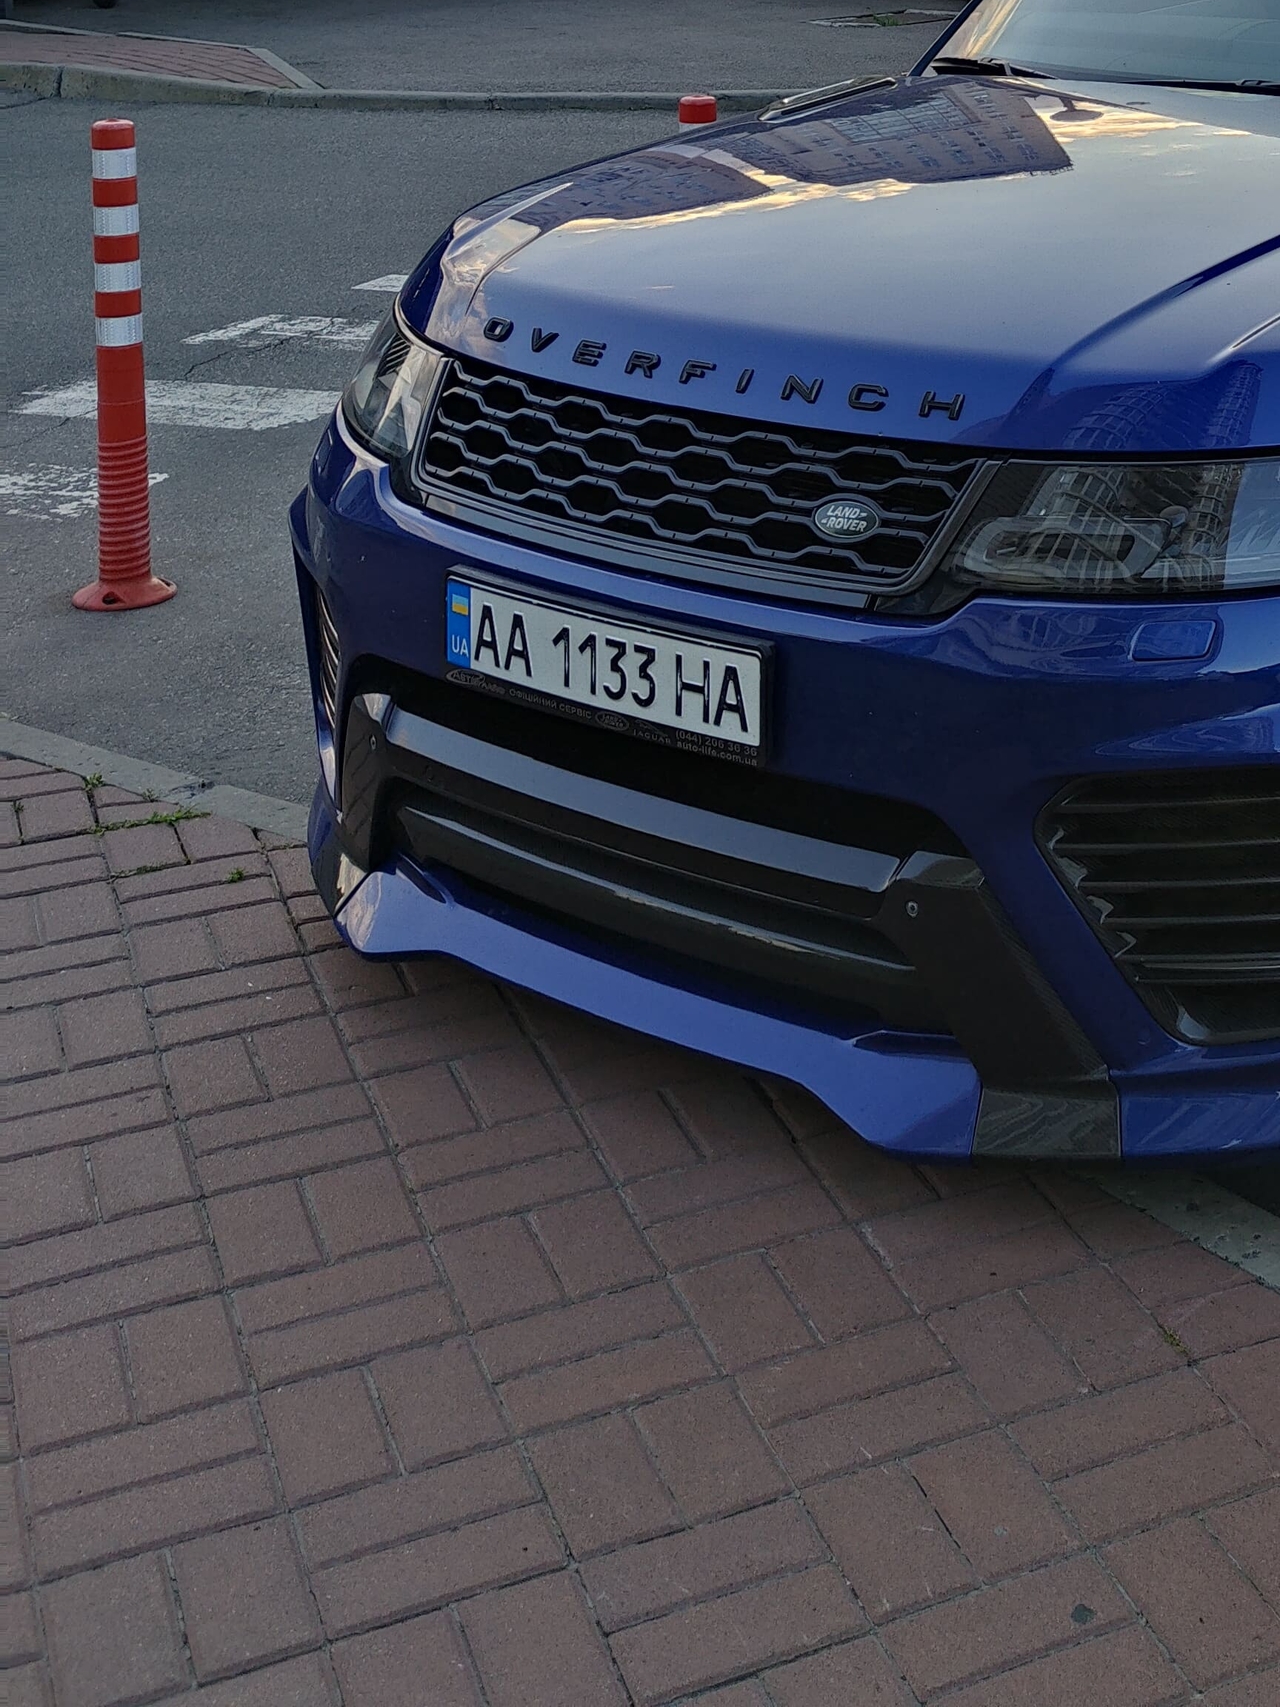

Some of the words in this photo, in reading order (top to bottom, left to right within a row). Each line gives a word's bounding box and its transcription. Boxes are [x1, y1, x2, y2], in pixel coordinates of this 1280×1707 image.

[483, 316, 966, 421] OVERFINCH
[452, 634, 469, 658] UA
[474, 602, 533, 678] AA
[552, 624, 656, 708] 1133
[675, 652, 749, 732] HA
[559, 702, 593, 719] СЕРВІС
[676, 729, 702, 745] (044)
[728, 741, 741, 753] 36
[744, 746, 758, 757] 36
[677, 740, 758, 767] auto-life.com.ua
